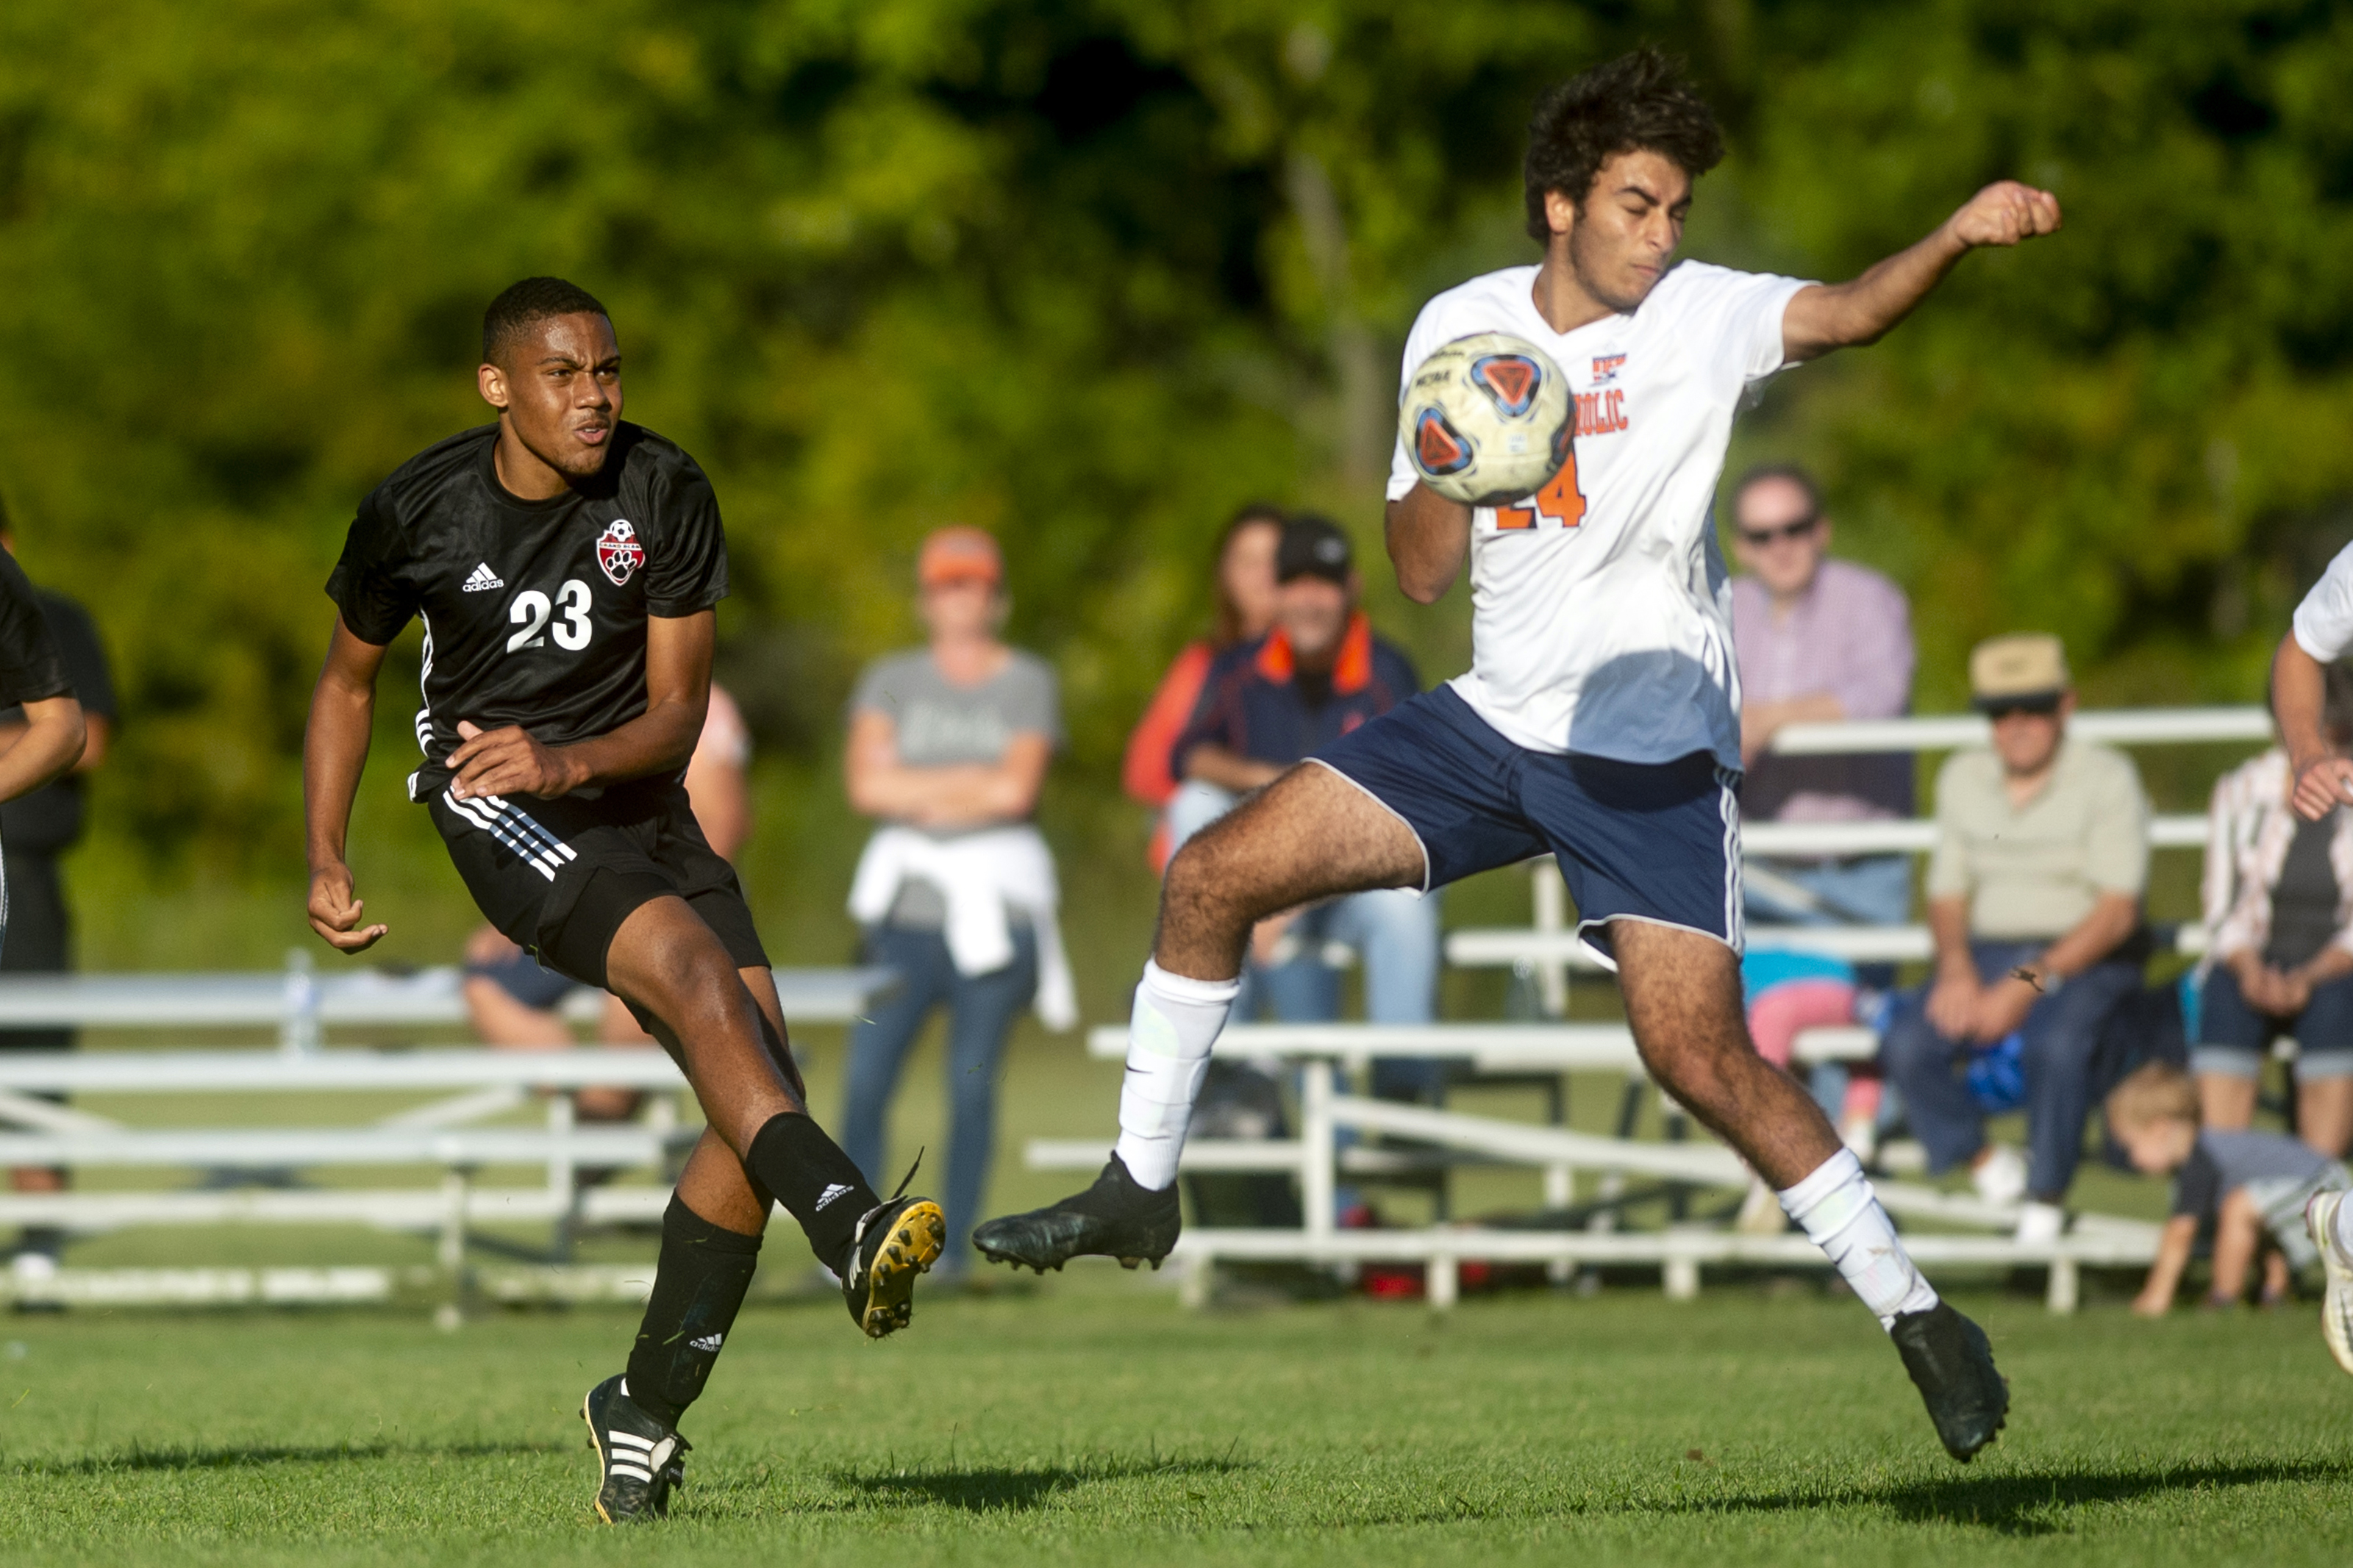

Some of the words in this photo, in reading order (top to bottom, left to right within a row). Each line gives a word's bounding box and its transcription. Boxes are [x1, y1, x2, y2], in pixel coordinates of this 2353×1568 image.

[463, 579, 504, 593] adidas
[507, 579, 593, 654] 23
[815, 1185, 854, 1212] adidas
[690, 1339, 721, 1353] adida
